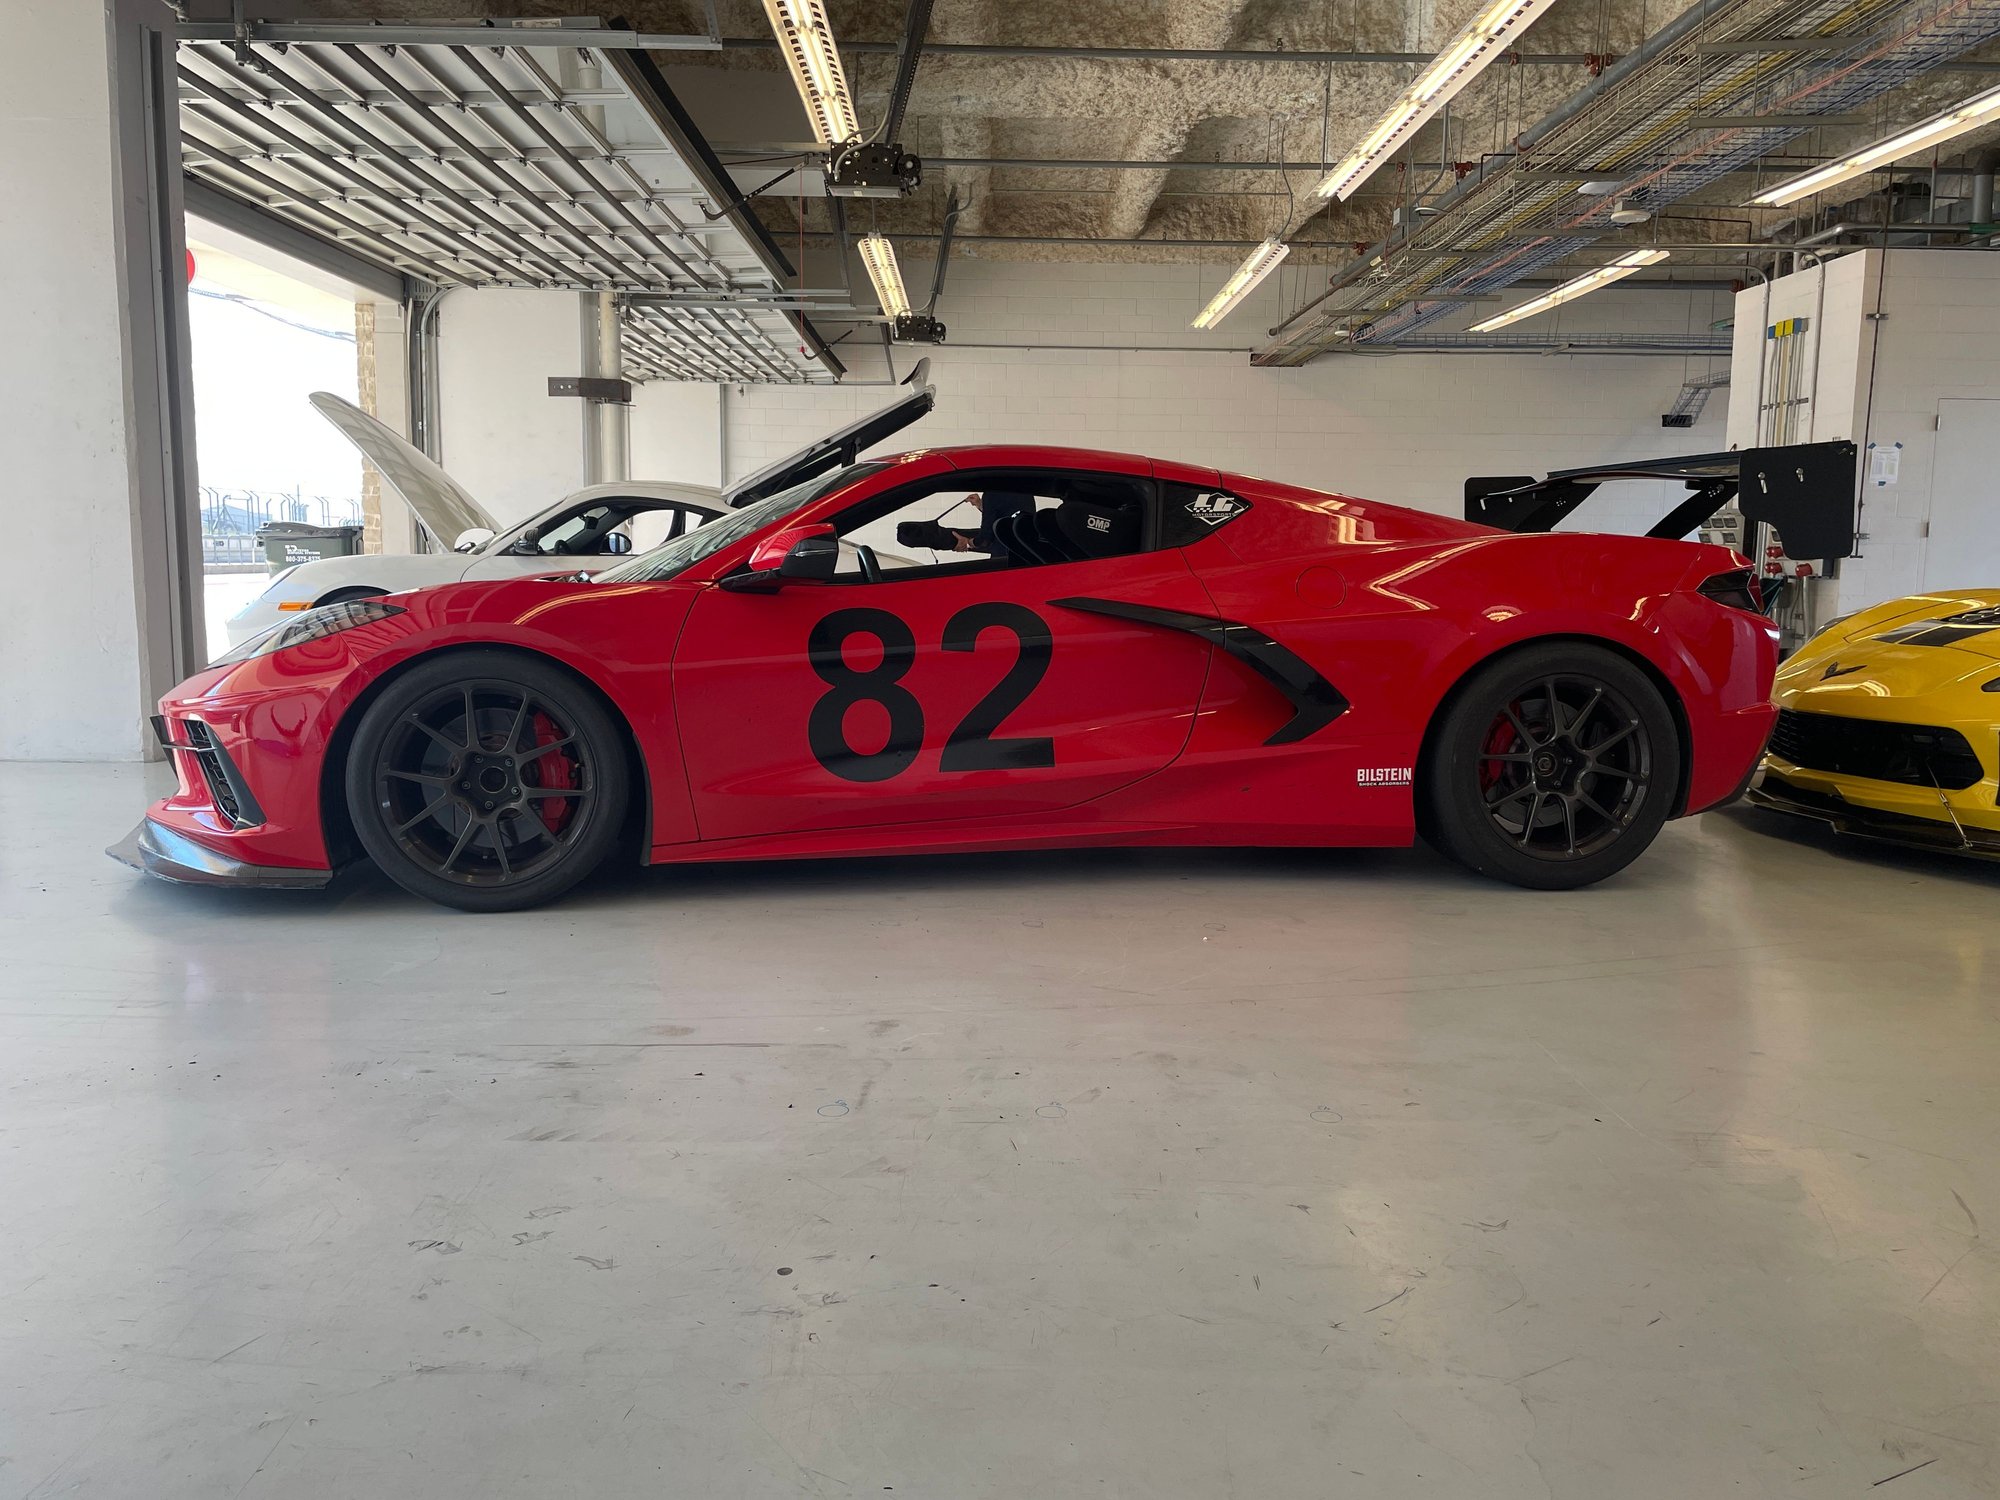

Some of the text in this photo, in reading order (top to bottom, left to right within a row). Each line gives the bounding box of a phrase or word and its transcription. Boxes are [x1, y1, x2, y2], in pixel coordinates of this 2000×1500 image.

[1087, 517, 1110, 531] OMP
[807, 601, 1056, 783] 82
[1357, 768, 1412, 781] BILSTEIN
